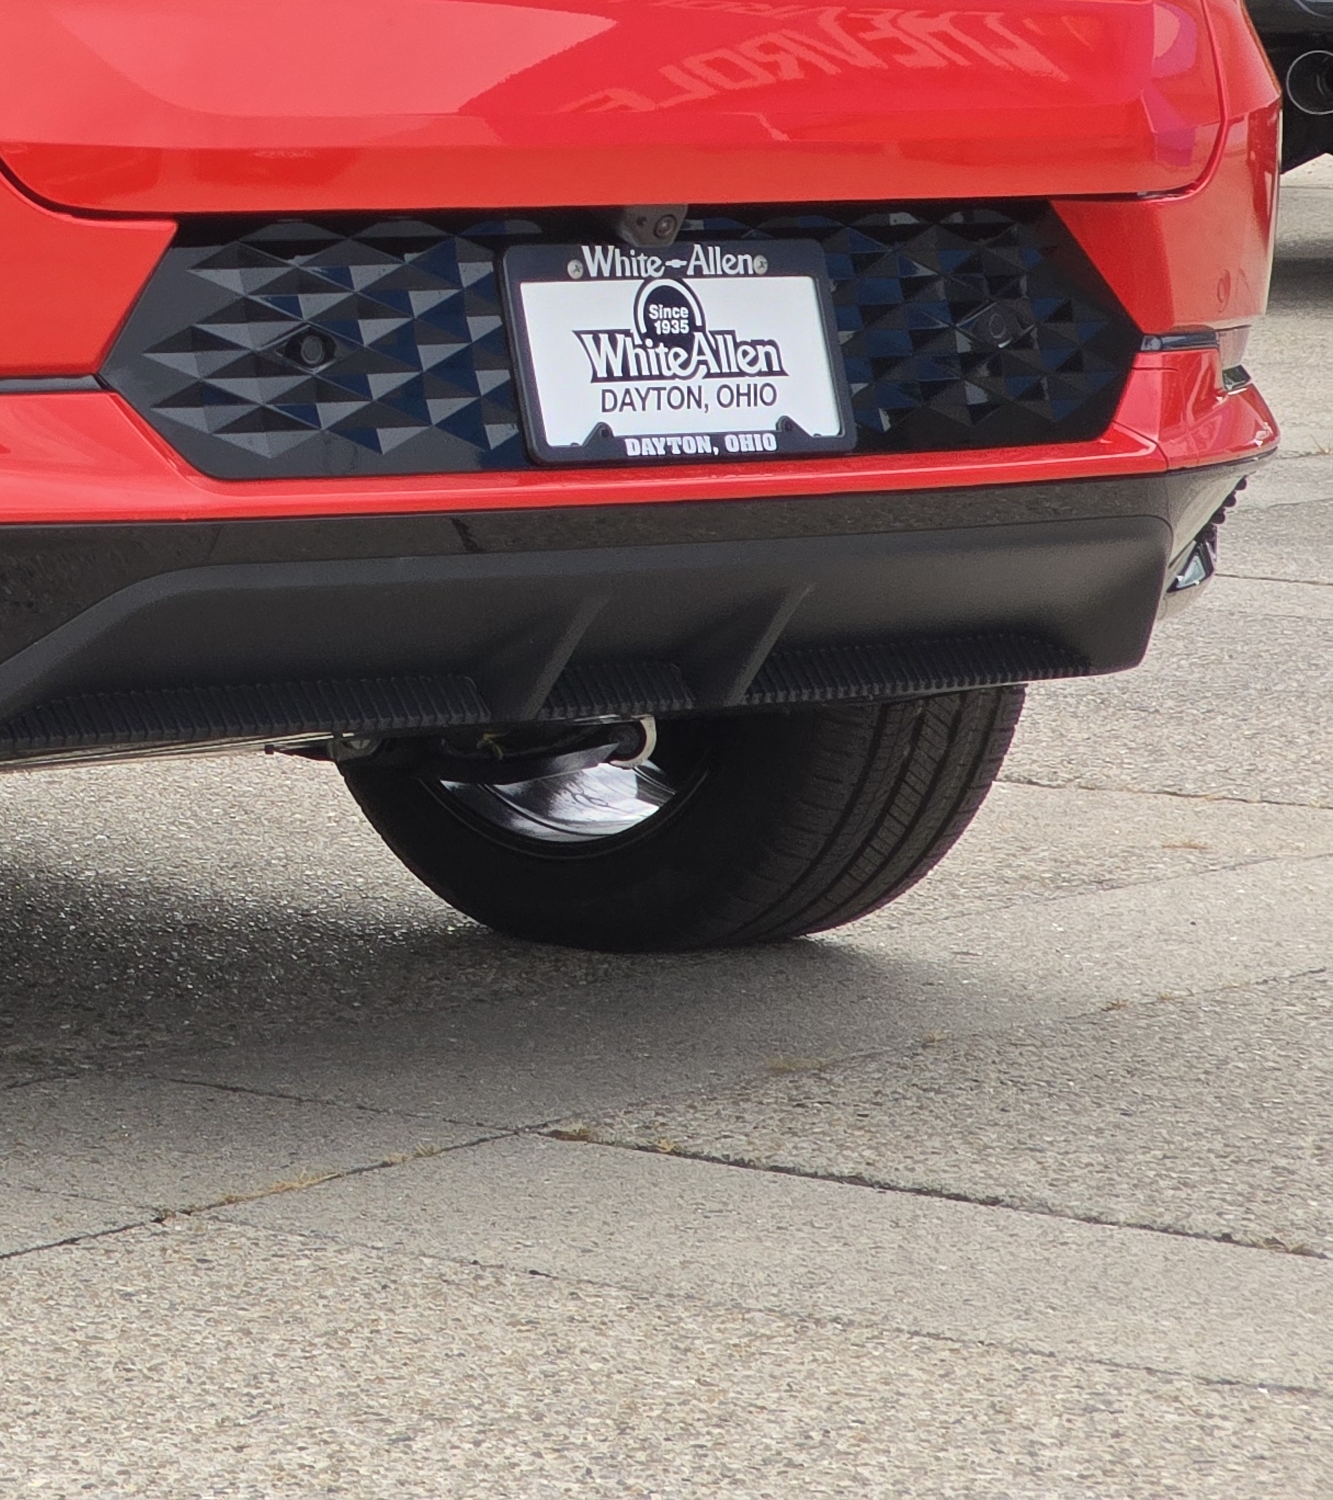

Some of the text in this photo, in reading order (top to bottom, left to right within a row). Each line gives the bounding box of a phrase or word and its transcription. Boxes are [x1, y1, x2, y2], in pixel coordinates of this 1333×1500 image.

[582, 244, 753, 278] White-Allen
[649, 303, 689, 319] Since
[654, 319, 689, 335] 1935
[601, 382, 777, 413] DAYTON, OHIO
[625, 432, 778, 456] DAYTON, OHIO
